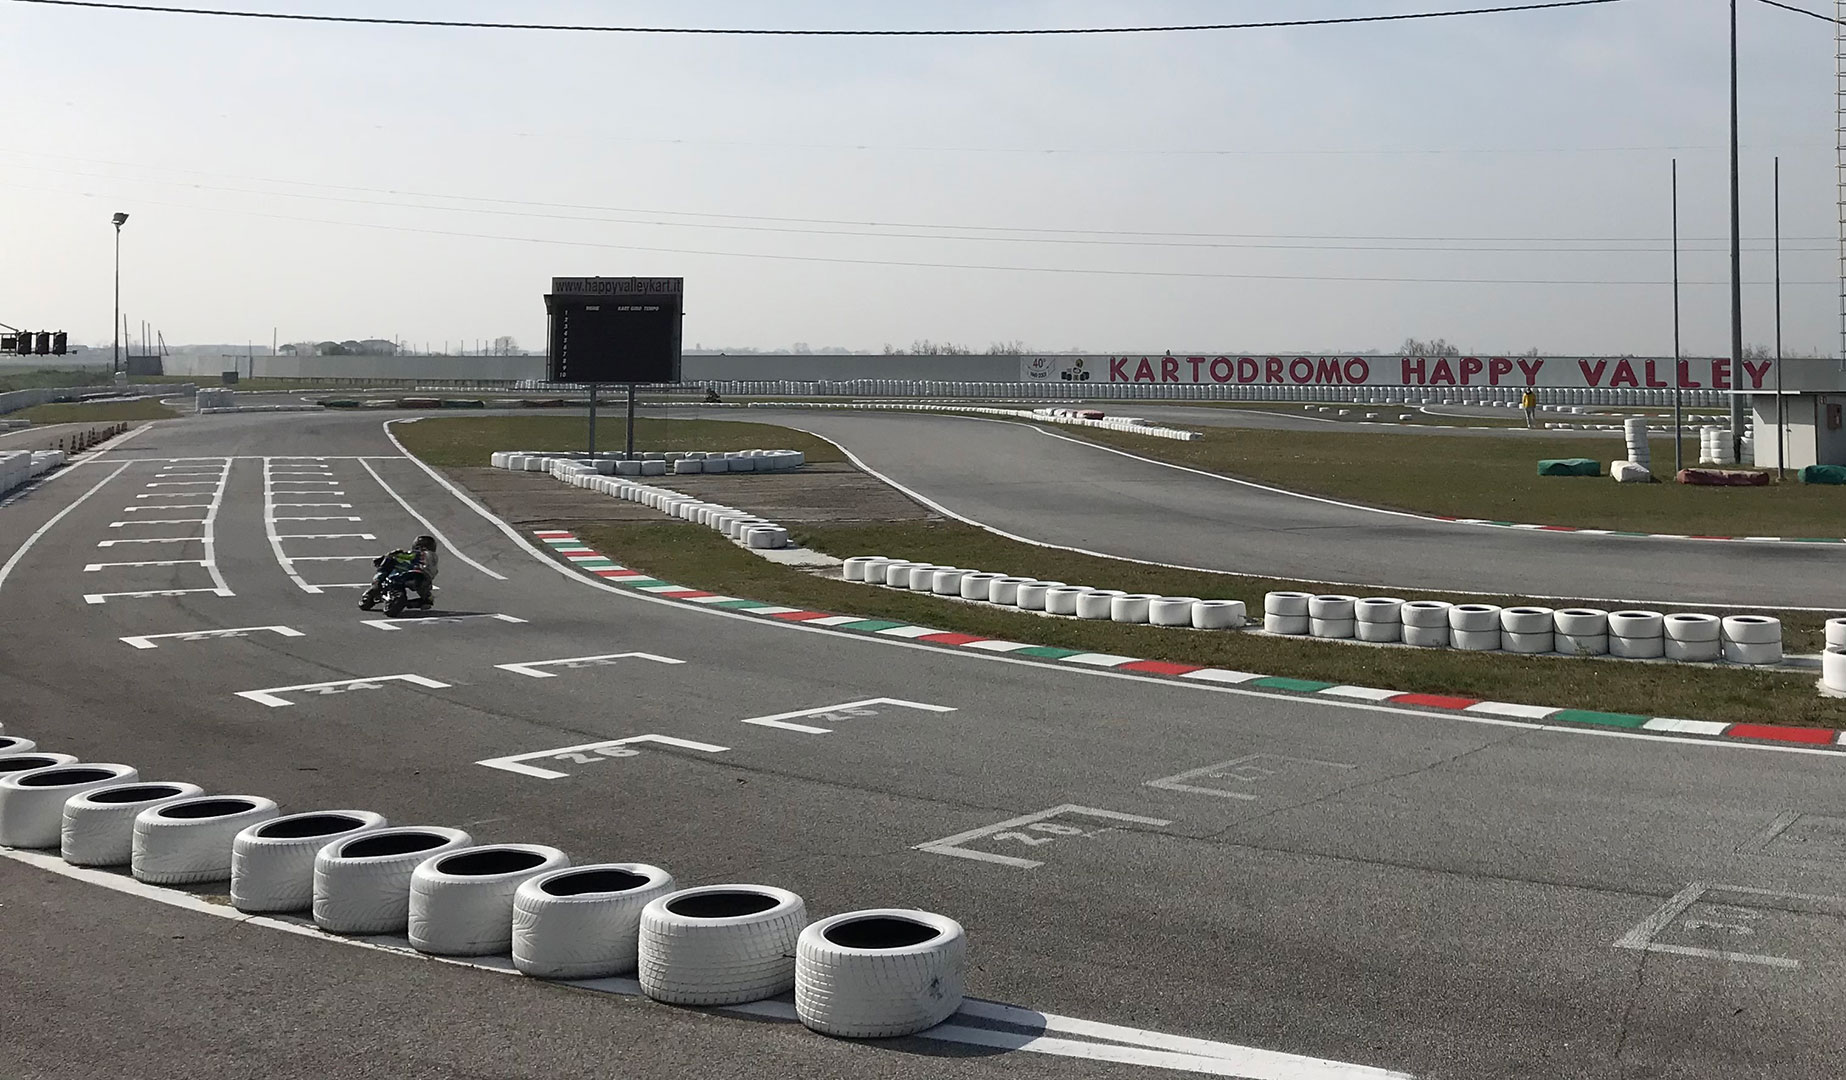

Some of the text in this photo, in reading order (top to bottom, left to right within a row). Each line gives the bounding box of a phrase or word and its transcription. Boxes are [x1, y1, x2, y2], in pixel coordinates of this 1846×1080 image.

[555, 279, 681, 294] www.happyvalleykart.it
[1110, 356, 1773, 389] KARTODROMO HAPPY VALLEY
[553, 746, 640, 764] 26
[992, 823, 1082, 846] 28
